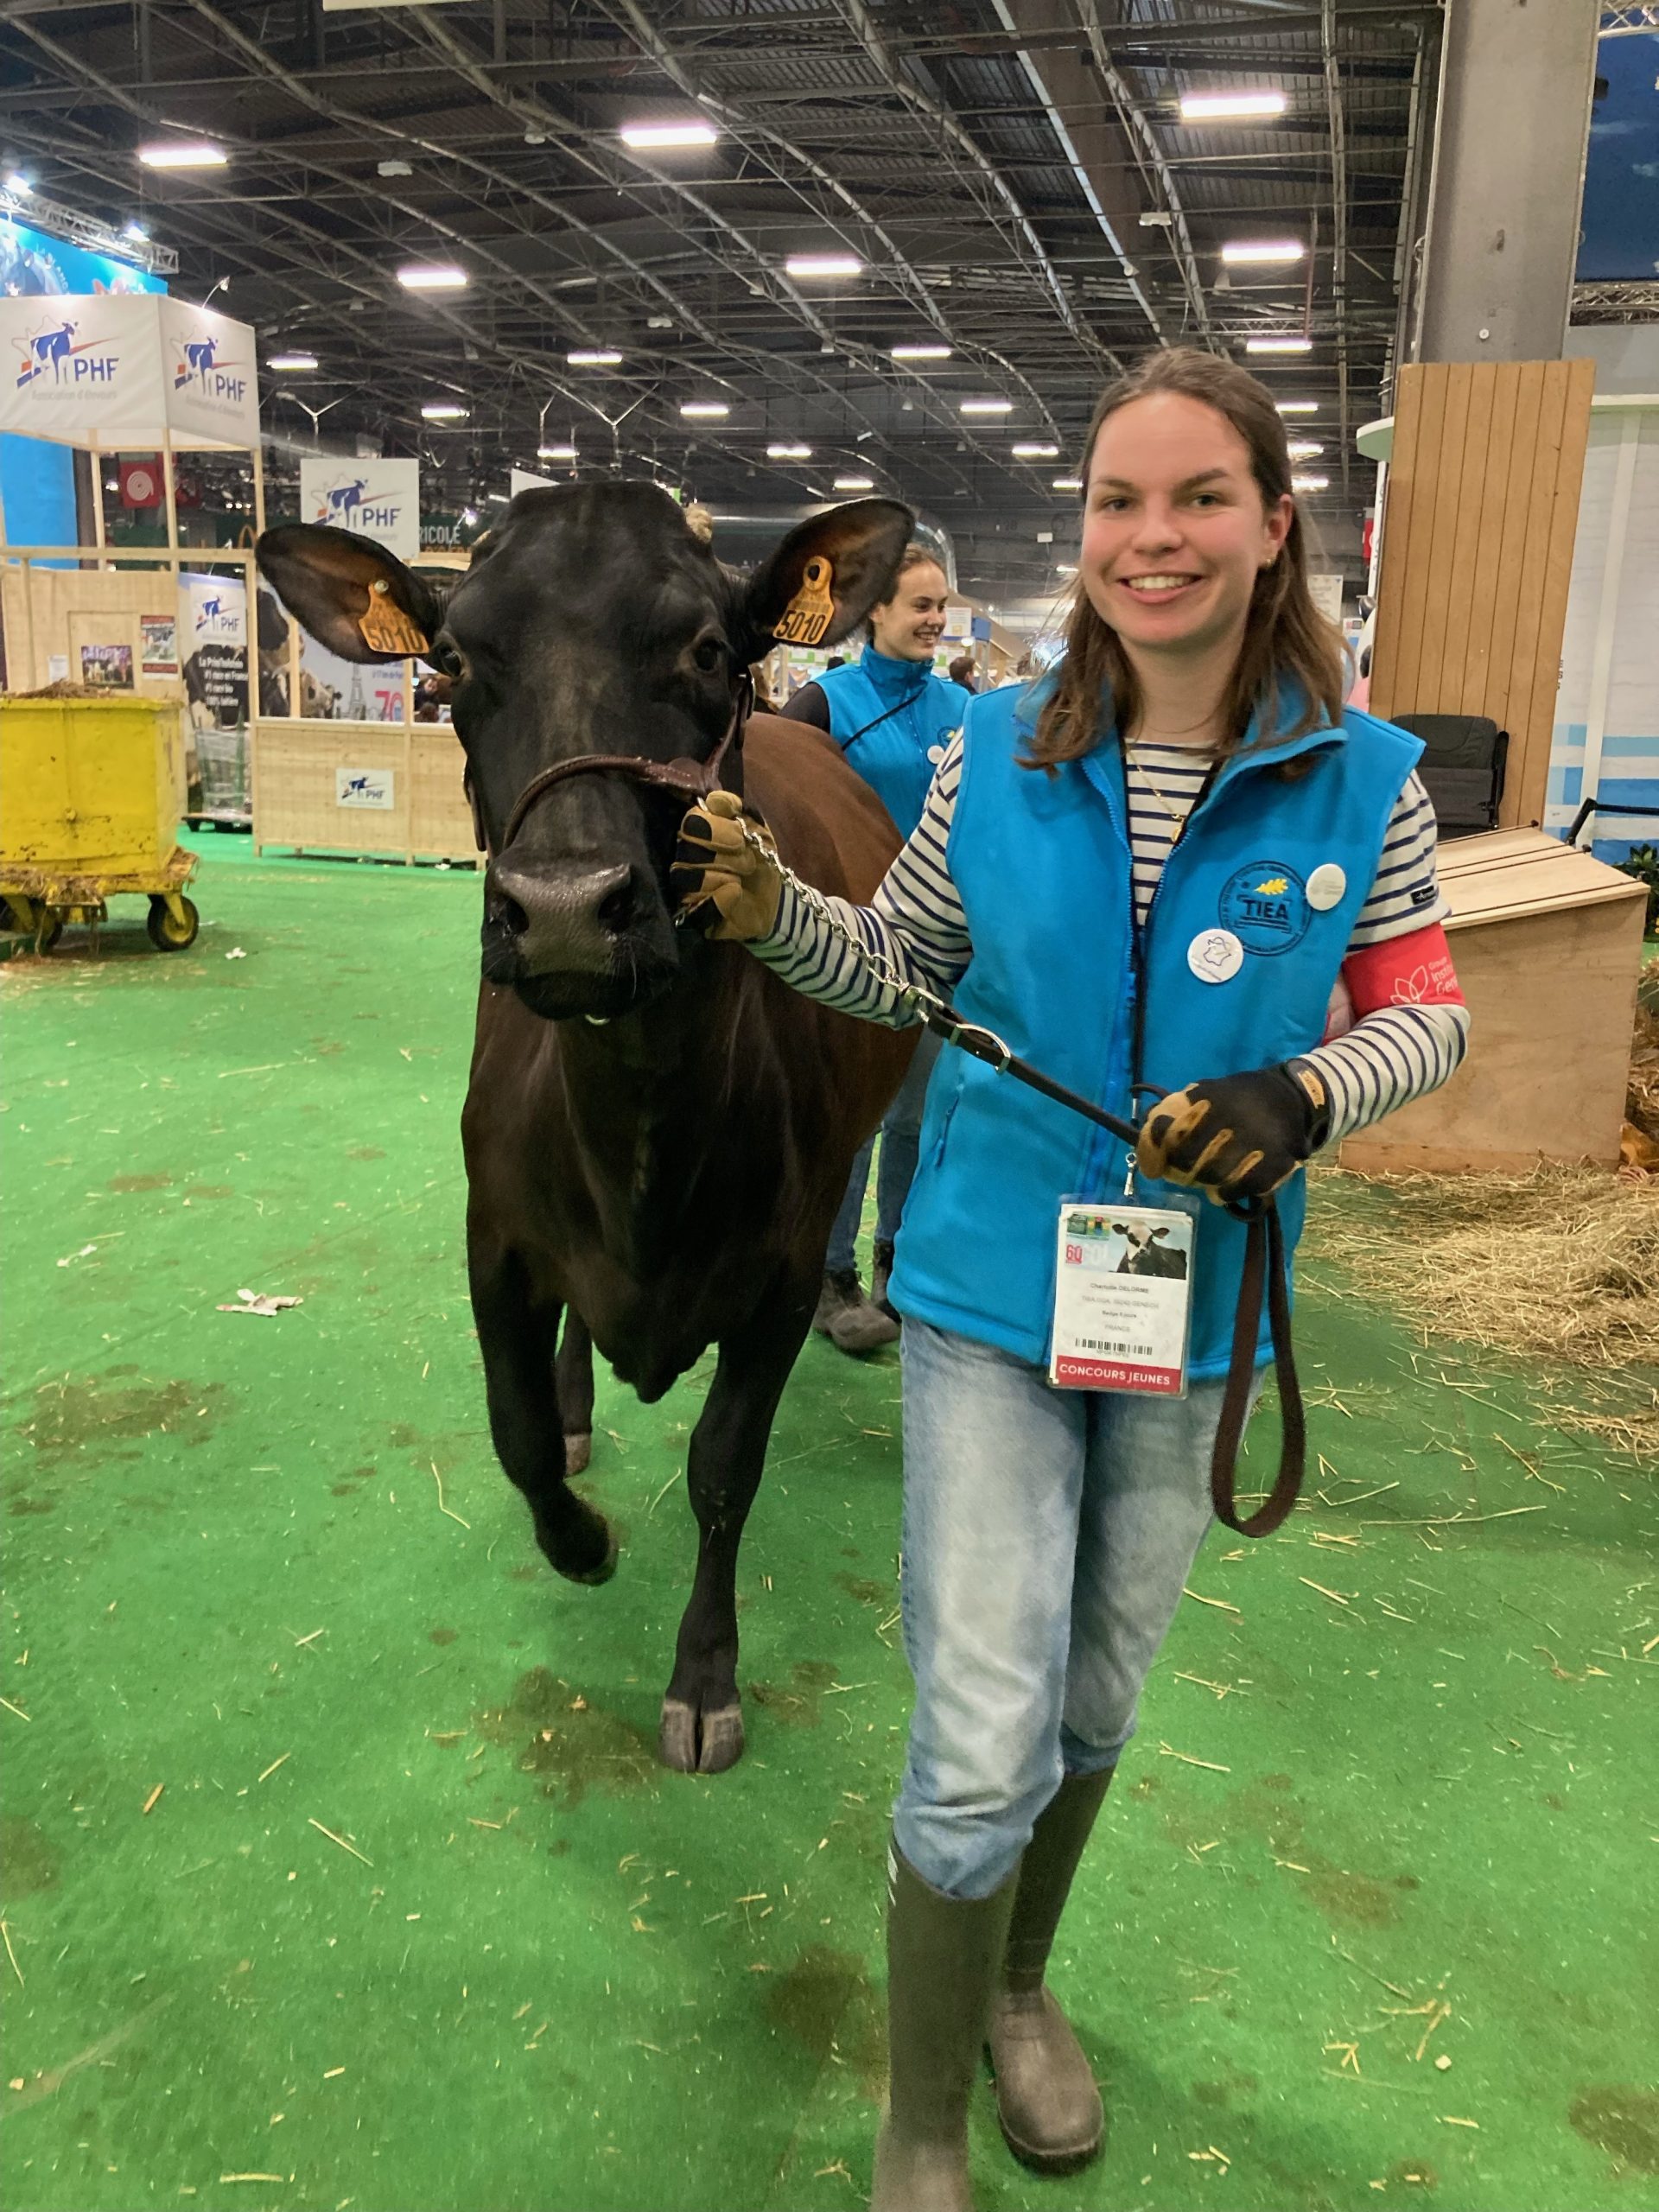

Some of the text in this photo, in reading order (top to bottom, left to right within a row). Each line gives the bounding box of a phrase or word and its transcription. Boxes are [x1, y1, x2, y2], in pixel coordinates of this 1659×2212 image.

[74, 358, 120, 382] PHF
[216, 374, 247, 402] PHF
[363, 508, 402, 527] PHF
[220, 617, 240, 632] PHF
[776, 610, 826, 642] 5010
[366, 626, 424, 652] 5010
[375, 690, 404, 721] 70
[366, 790, 385, 799] PHF
[1243, 899, 1288, 920] TIEA
[1058, 1363, 1170, 1385] CONCOURS JEUNES
